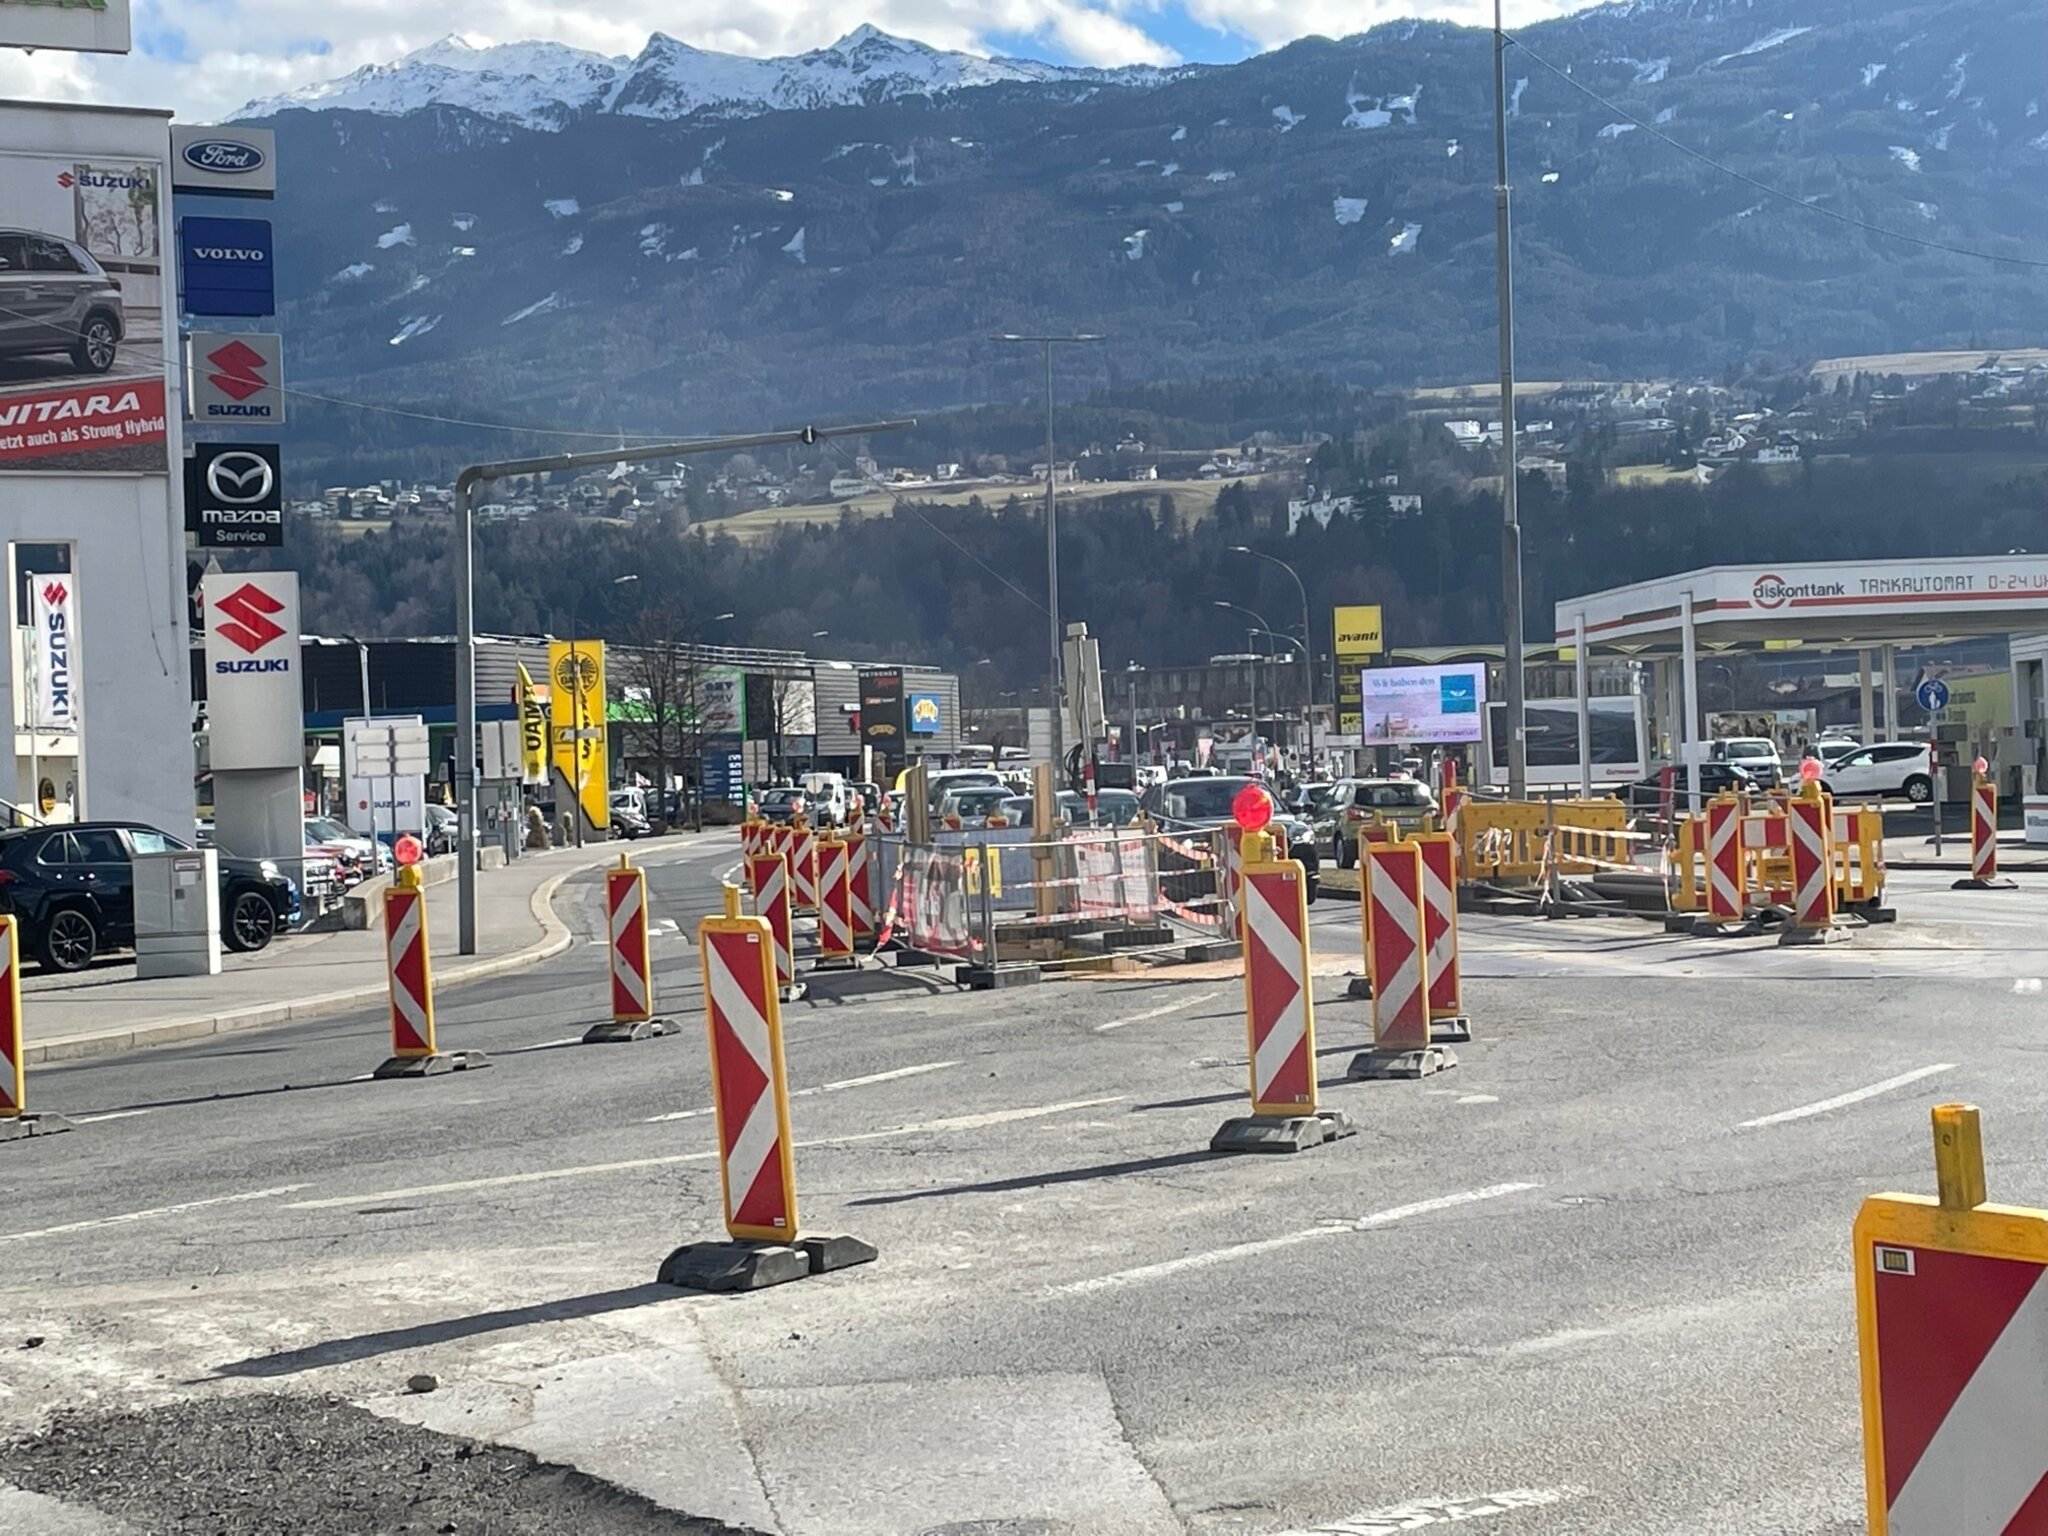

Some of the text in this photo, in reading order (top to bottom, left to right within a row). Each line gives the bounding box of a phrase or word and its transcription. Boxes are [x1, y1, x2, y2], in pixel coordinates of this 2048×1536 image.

[201, 144, 249, 166] Ford
[79, 175, 150, 189] SUZUKI
[193, 247, 264, 261] VOLVO
[208, 404, 271, 416] SUZUKI
[0, 416, 165, 450] etzt auch als Strong Hybrid
[202, 510, 281, 524] mazda
[216, 529, 266, 542] Service
[1753, 581, 1845, 598] diskonttank
[1860, 575, 1974, 594] TANKAUTOMAT
[1988, 574, 2028, 590] 0-24
[1338, 631, 1379, 642] avanti
[48, 612, 69, 716] SUZUKI
[215, 658, 289, 674] SUZUKI
